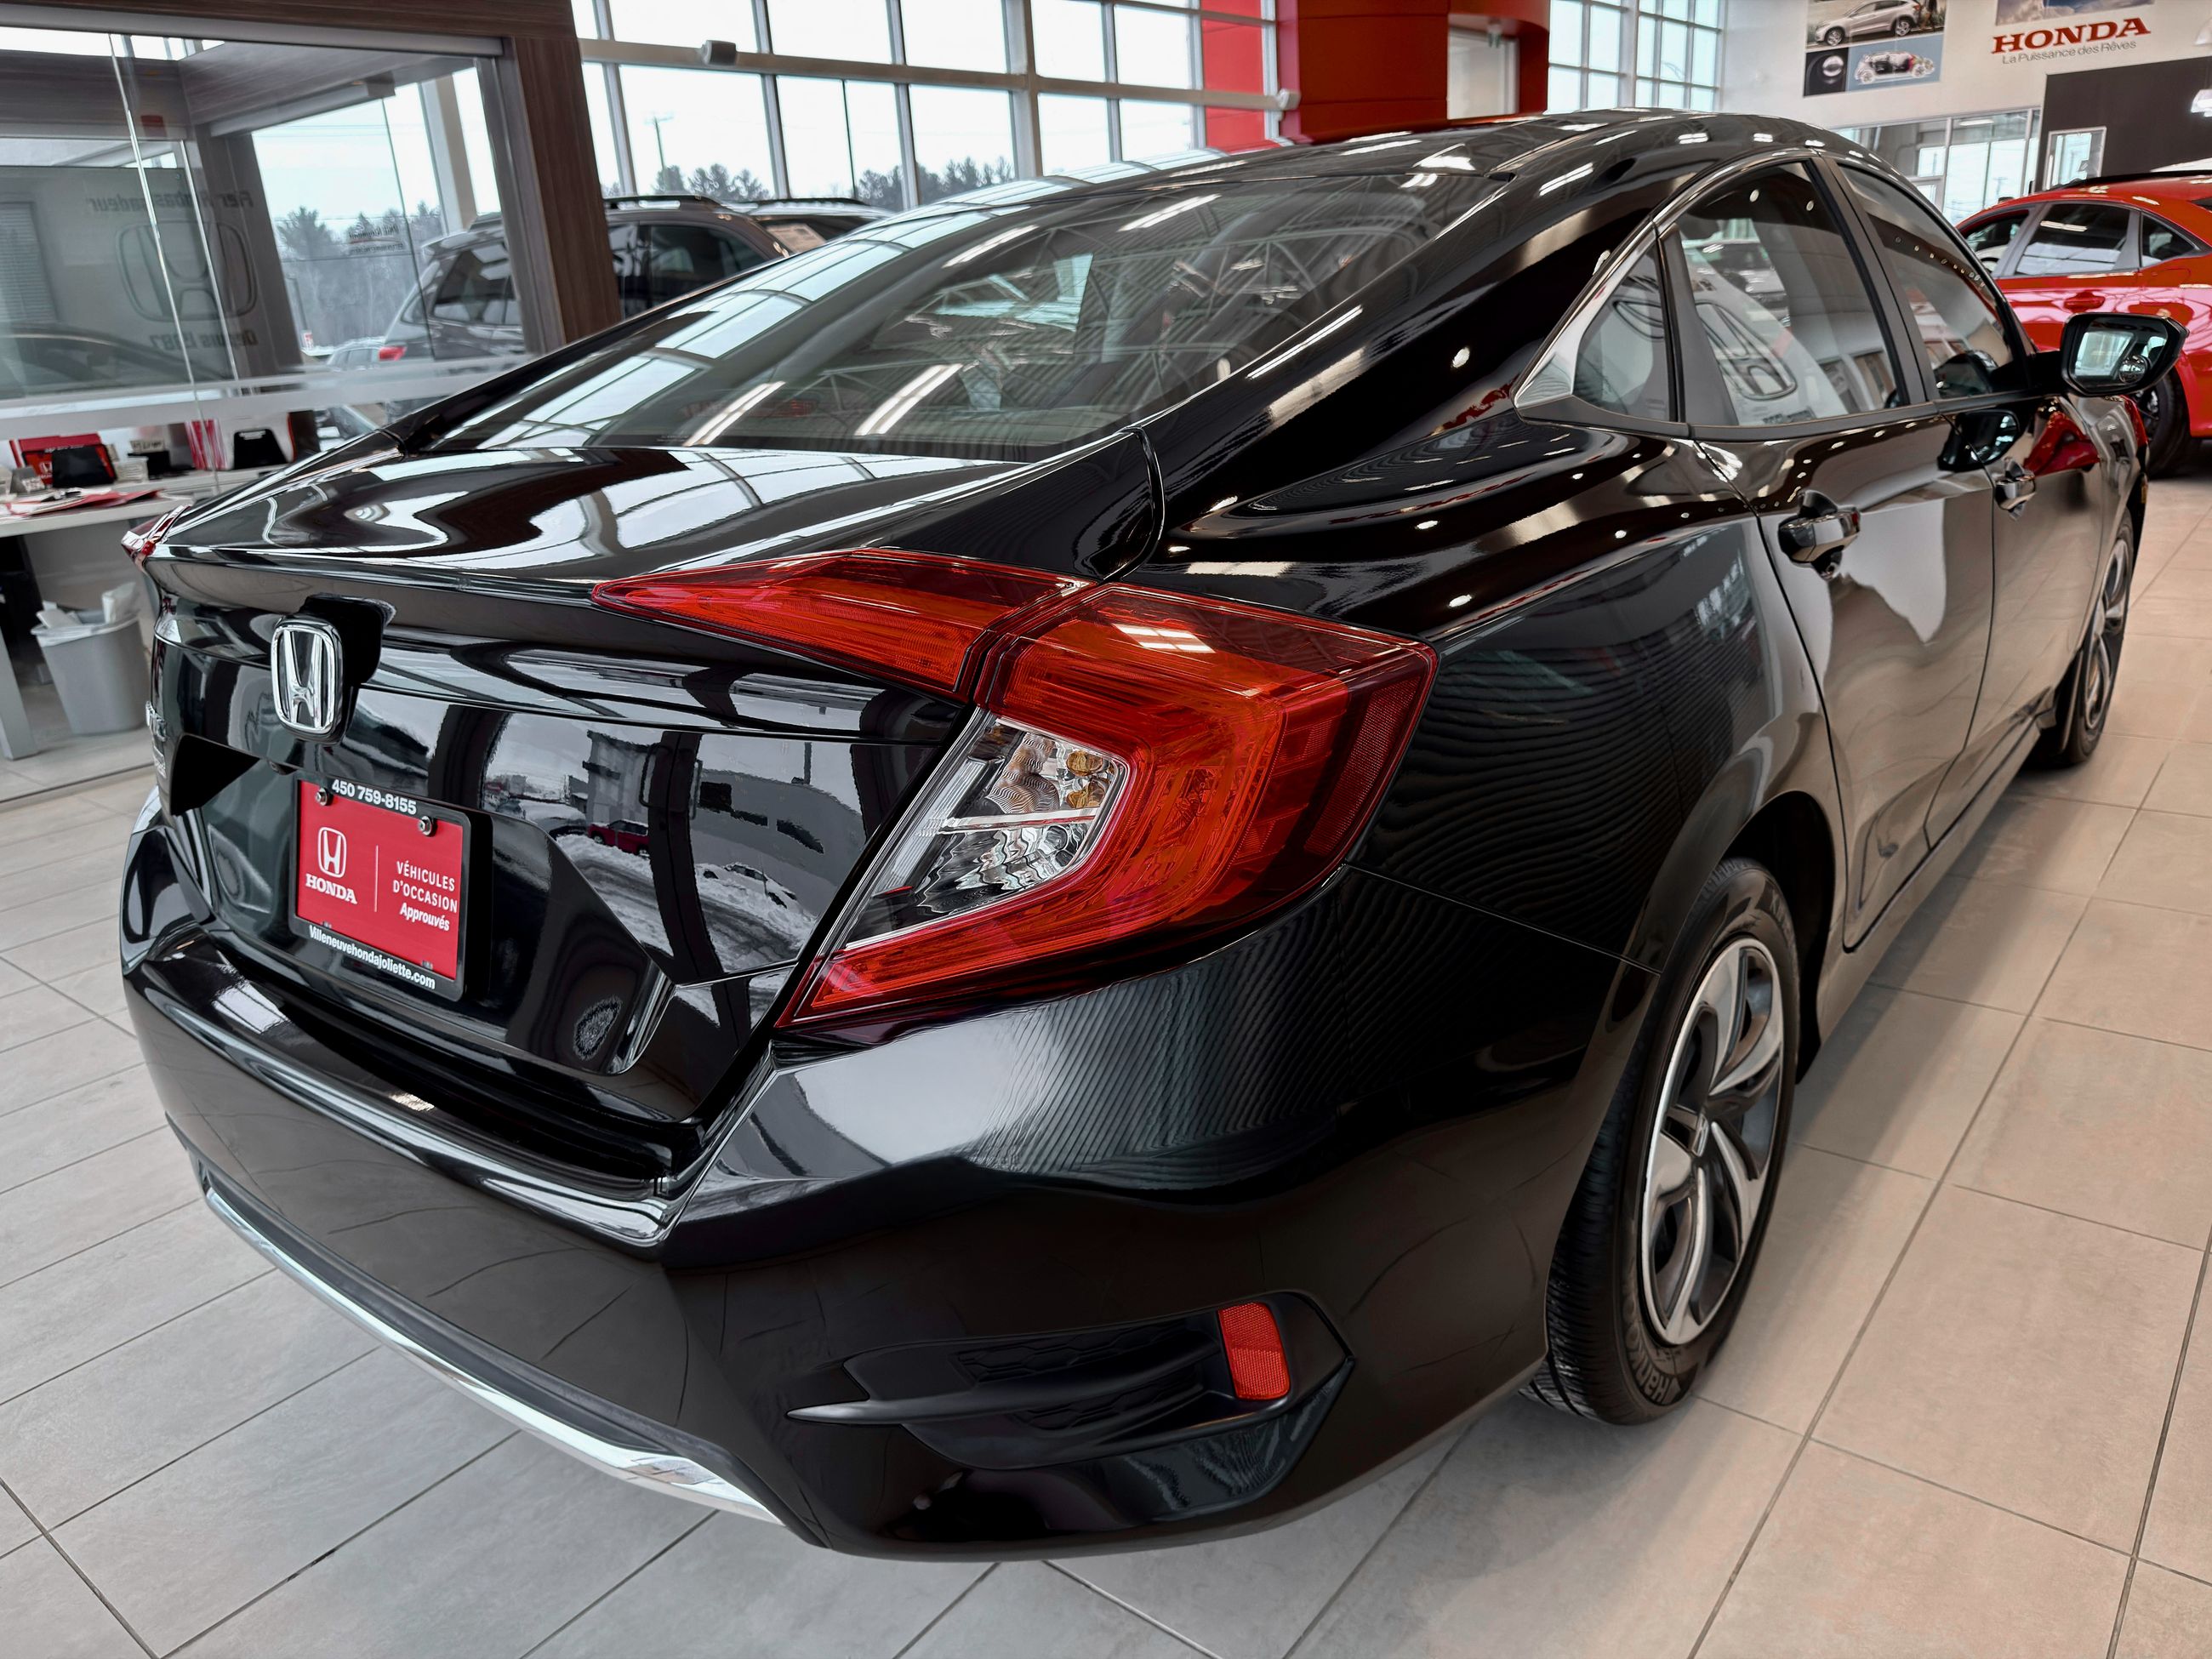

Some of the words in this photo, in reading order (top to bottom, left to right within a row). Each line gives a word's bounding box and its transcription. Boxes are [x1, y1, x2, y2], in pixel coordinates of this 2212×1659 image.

[1991, 17, 2151, 54] HONDA
[2002, 54, 2016, 65] La
[2018, 48, 2076, 63] Puissance
[2078, 44, 2099, 56] des
[2101, 41, 2137, 54] Rêves
[332, 779, 356, 797] 450
[357, 785, 417, 815] 759-8155
[305, 873, 357, 904] HONDA
[396, 860, 455, 892] VÉHICULES
[393, 880, 458, 913] D'OCCASION
[400, 902, 450, 932] Approuvés
[309, 924, 436, 989] Villeneuvehondajoliette.com
